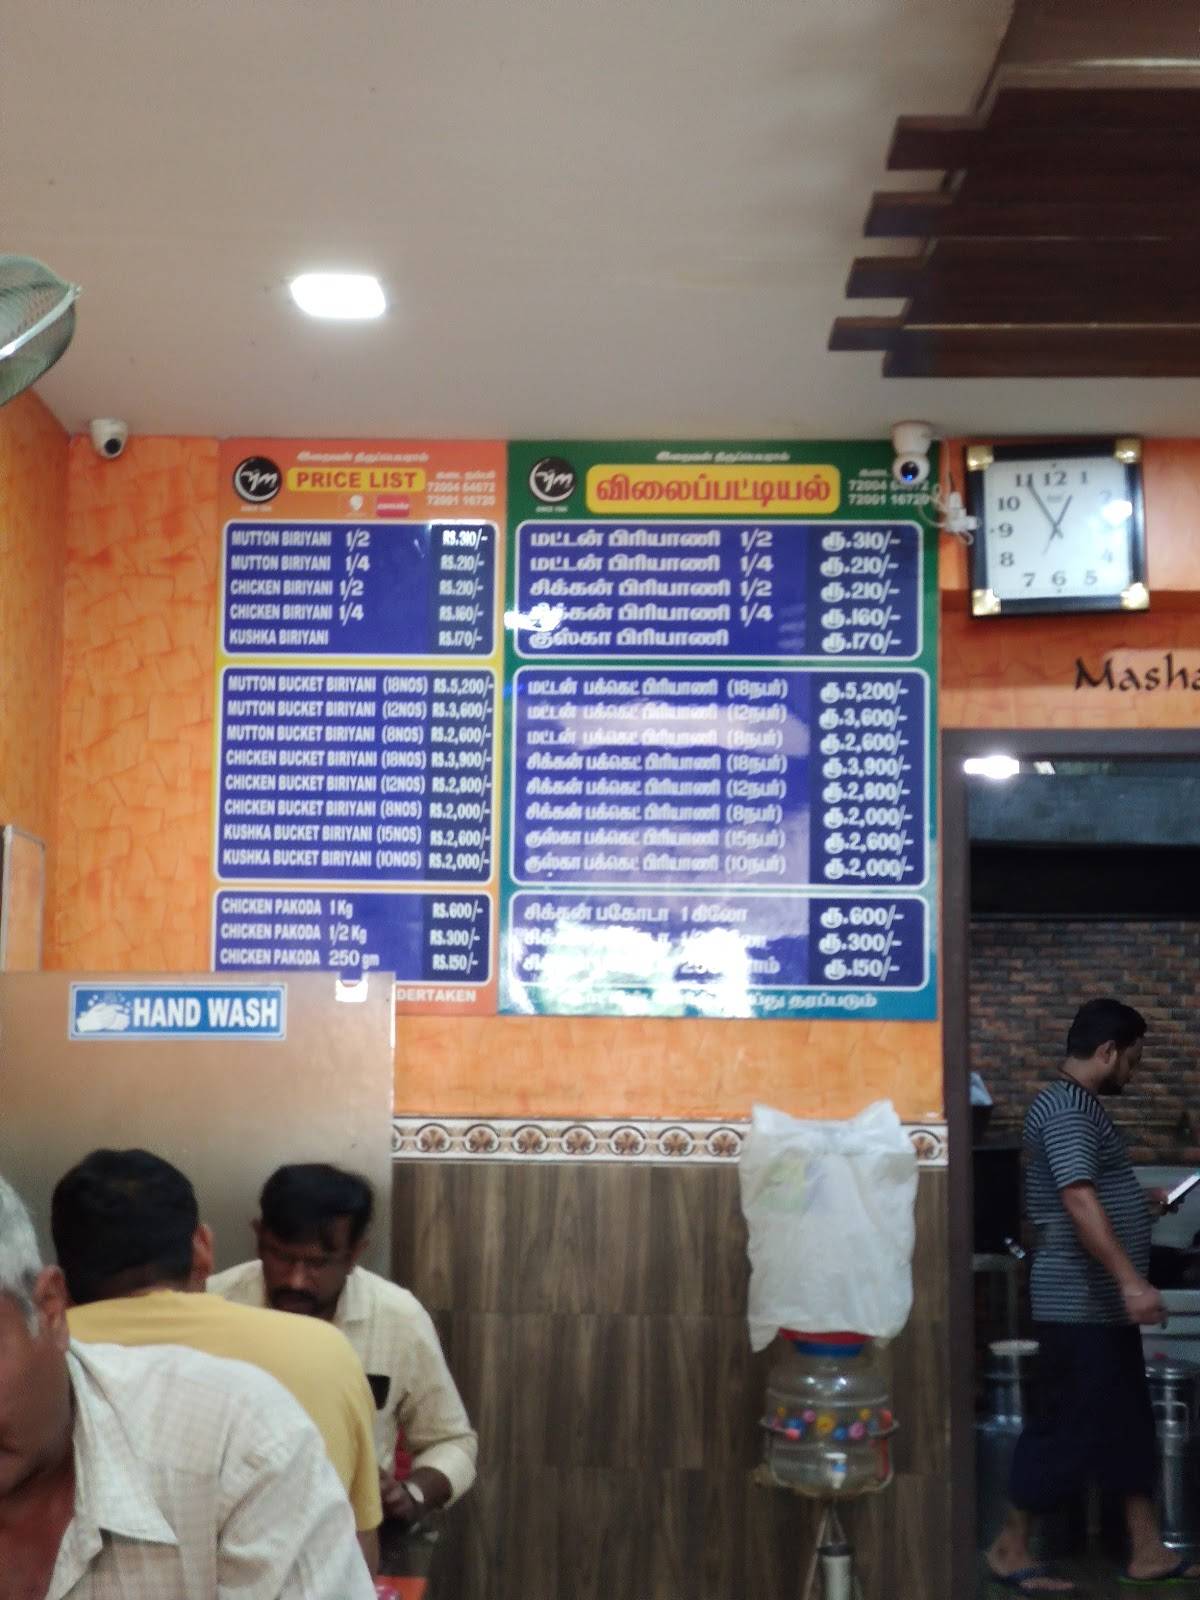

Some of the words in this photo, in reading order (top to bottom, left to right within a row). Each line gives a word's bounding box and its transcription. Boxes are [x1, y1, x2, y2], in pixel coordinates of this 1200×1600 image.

[297, 472, 360, 489] PRICE
[370, 472, 417, 489] LIST
[1044, 471, 1067, 486] 12
[1080, 471, 1088, 485] 1
[596, 473, 831, 507] விலைப்பட்டியல்
[998, 496, 1021, 511] 10
[232, 531, 279, 547] MUTTON
[282, 531, 331, 547] BIRIYANI
[346, 529, 370, 552] 1/2
[531, 529, 603, 546] மட்டன்
[608, 529, 720, 546] பிரியாணி
[740, 529, 773, 552] 1/2
[999, 523, 1014, 538] 9
[231, 555, 279, 571] MUTTON
[281, 555, 331, 571] BIRIYANI
[346, 554, 370, 576] 1/4
[530, 553, 603, 571] மட்டன்
[608, 553, 720, 571] பிரியாணி
[740, 553, 774, 577] 1/4
[1000, 552, 1015, 568] 8
[1023, 573, 1036, 588] 7
[1051, 571, 1067, 586] 6
[1084, 570, 1098, 585] 5
[231, 580, 281, 596] CHICKEN
[283, 580, 333, 596] BIRIYANI
[339, 579, 364, 601] 1/2
[529, 578, 614, 596] சிக்கன்
[618, 579, 730, 596] பிரியாணி
[740, 578, 772, 602] 1/2
[230, 604, 280, 620] CHICKEN
[283, 604, 332, 620] BIRIYANI
[339, 604, 364, 626] 1/4
[618, 604, 730, 621] பிரியாணி
[740, 602, 774, 627] 1/4
[229, 629, 276, 645] KUSHKA
[279, 629, 328, 645] BIRIYANI
[529, 628, 611, 649] குஸ்கா
[616, 628, 729, 646] பிரியாணி
[228, 676, 276, 692] MUTTON
[278, 676, 324, 692] BUCKET
[326, 676, 376, 692] BIRIYANI
[383, 676, 428, 695] (18NOS)
[228, 701, 276, 717] MUTTON
[278, 701, 323, 717] BUCKET
[326, 701, 375, 717] BIRIYANI
[383, 701, 428, 720] (12NOS)
[227, 725, 275, 742] MUTTON
[277, 725, 323, 742] BUCKET
[325, 725, 375, 742] BIRIYANI
[382, 726, 424, 745] (8NOS)
[226, 750, 277, 767] CHICKEN
[279, 750, 325, 767] BUCKET
[327, 750, 377, 767] BIRIYANI
[381, 751, 427, 770] (18NOS)
[225, 775, 276, 791] CHICKEN
[278, 775, 324, 791] BUCKET
[326, 775, 377, 791] BIRIYANI
[381, 776, 426, 794] (12NOS)
[225, 799, 275, 816] CHICKEN
[278, 799, 324, 816] BUCKET
[326, 799, 376, 816] BIRIYANI
[380, 800, 422, 820] (8NOS)
[224, 824, 271, 841] KUSHKA
[274, 824, 319, 841] BUCKET
[322, 824, 372, 841] BIRIYANI
[376, 826, 422, 844] (15NOS)
[223, 849, 271, 865] KUSHKA
[273, 849, 319, 865] BUCKET
[321, 849, 372, 865] BIRIYANI
[376, 851, 421, 869] (10NOS)
[222, 898, 272, 915] CHICKEN
[275, 898, 321, 915] PAKODA
[221, 923, 272, 940] CHICKEN
[274, 923, 321, 941] PAKODA
[329, 922, 349, 946] 1/2
[220, 948, 271, 965] CHICKEN
[274, 948, 320, 966] PAKODA
[328, 949, 359, 967] 250
[134, 997, 200, 1028] HAND
[207, 998, 278, 1028] WASH
